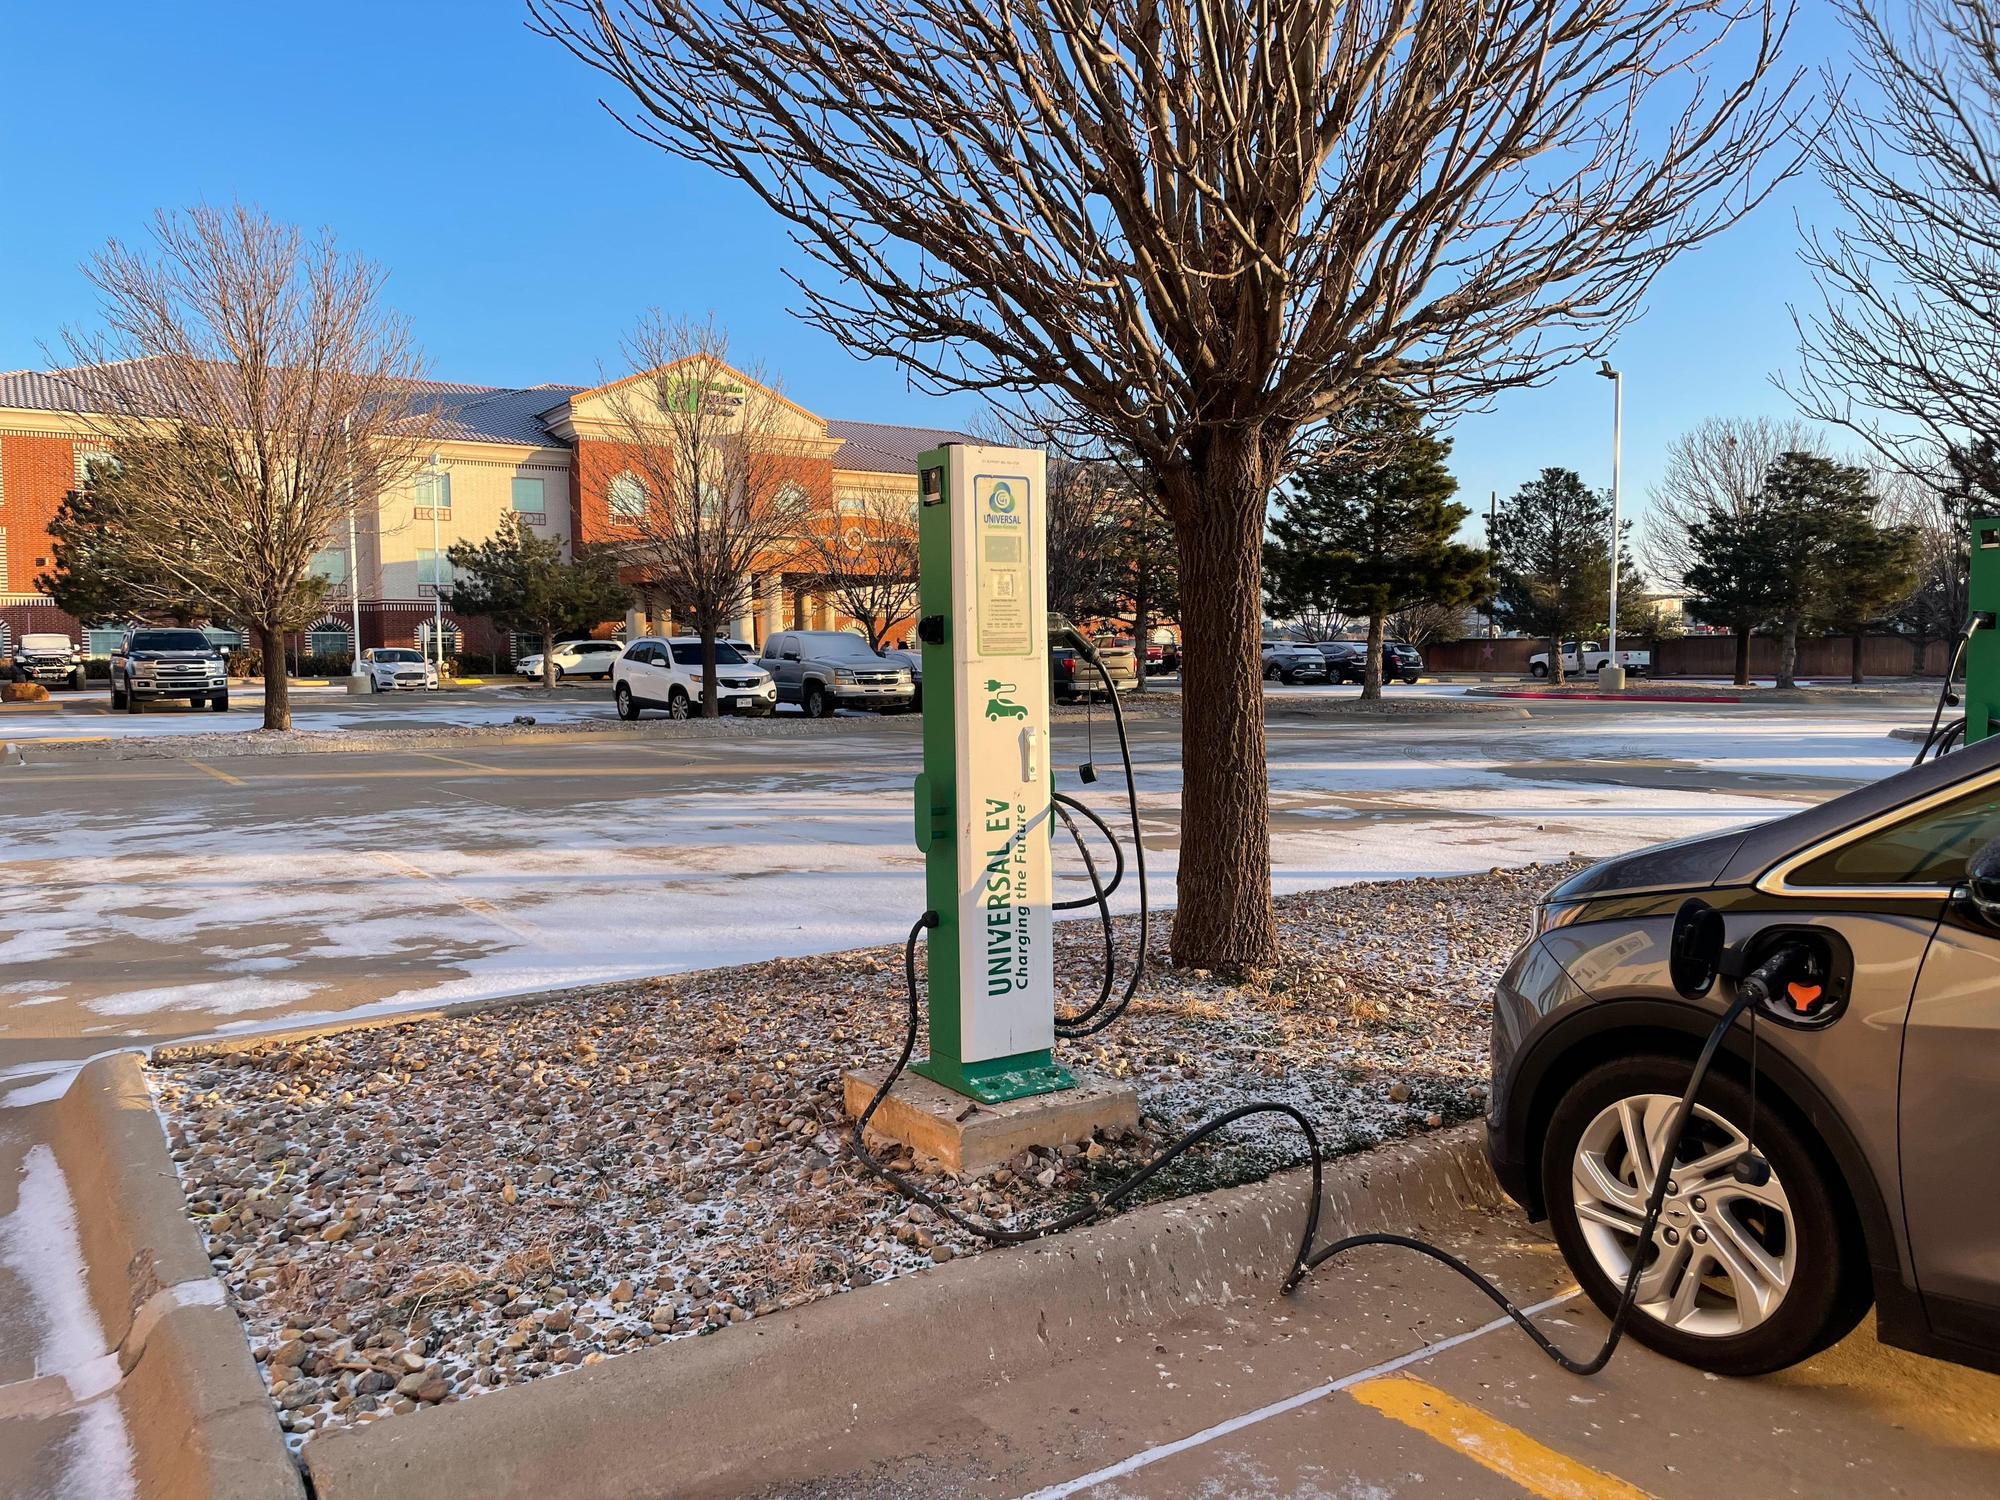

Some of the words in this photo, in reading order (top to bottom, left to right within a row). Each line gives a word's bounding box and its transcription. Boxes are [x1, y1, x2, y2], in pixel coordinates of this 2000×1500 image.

[983, 514, 1021, 524] UNIVERSAL
[986, 799, 1010, 832] EV
[1015, 804, 1027, 864] Future
[1015, 871, 1027, 899] the
[987, 842, 1012, 996] UNIVERSAL
[1015, 906, 1030, 990] Charging
